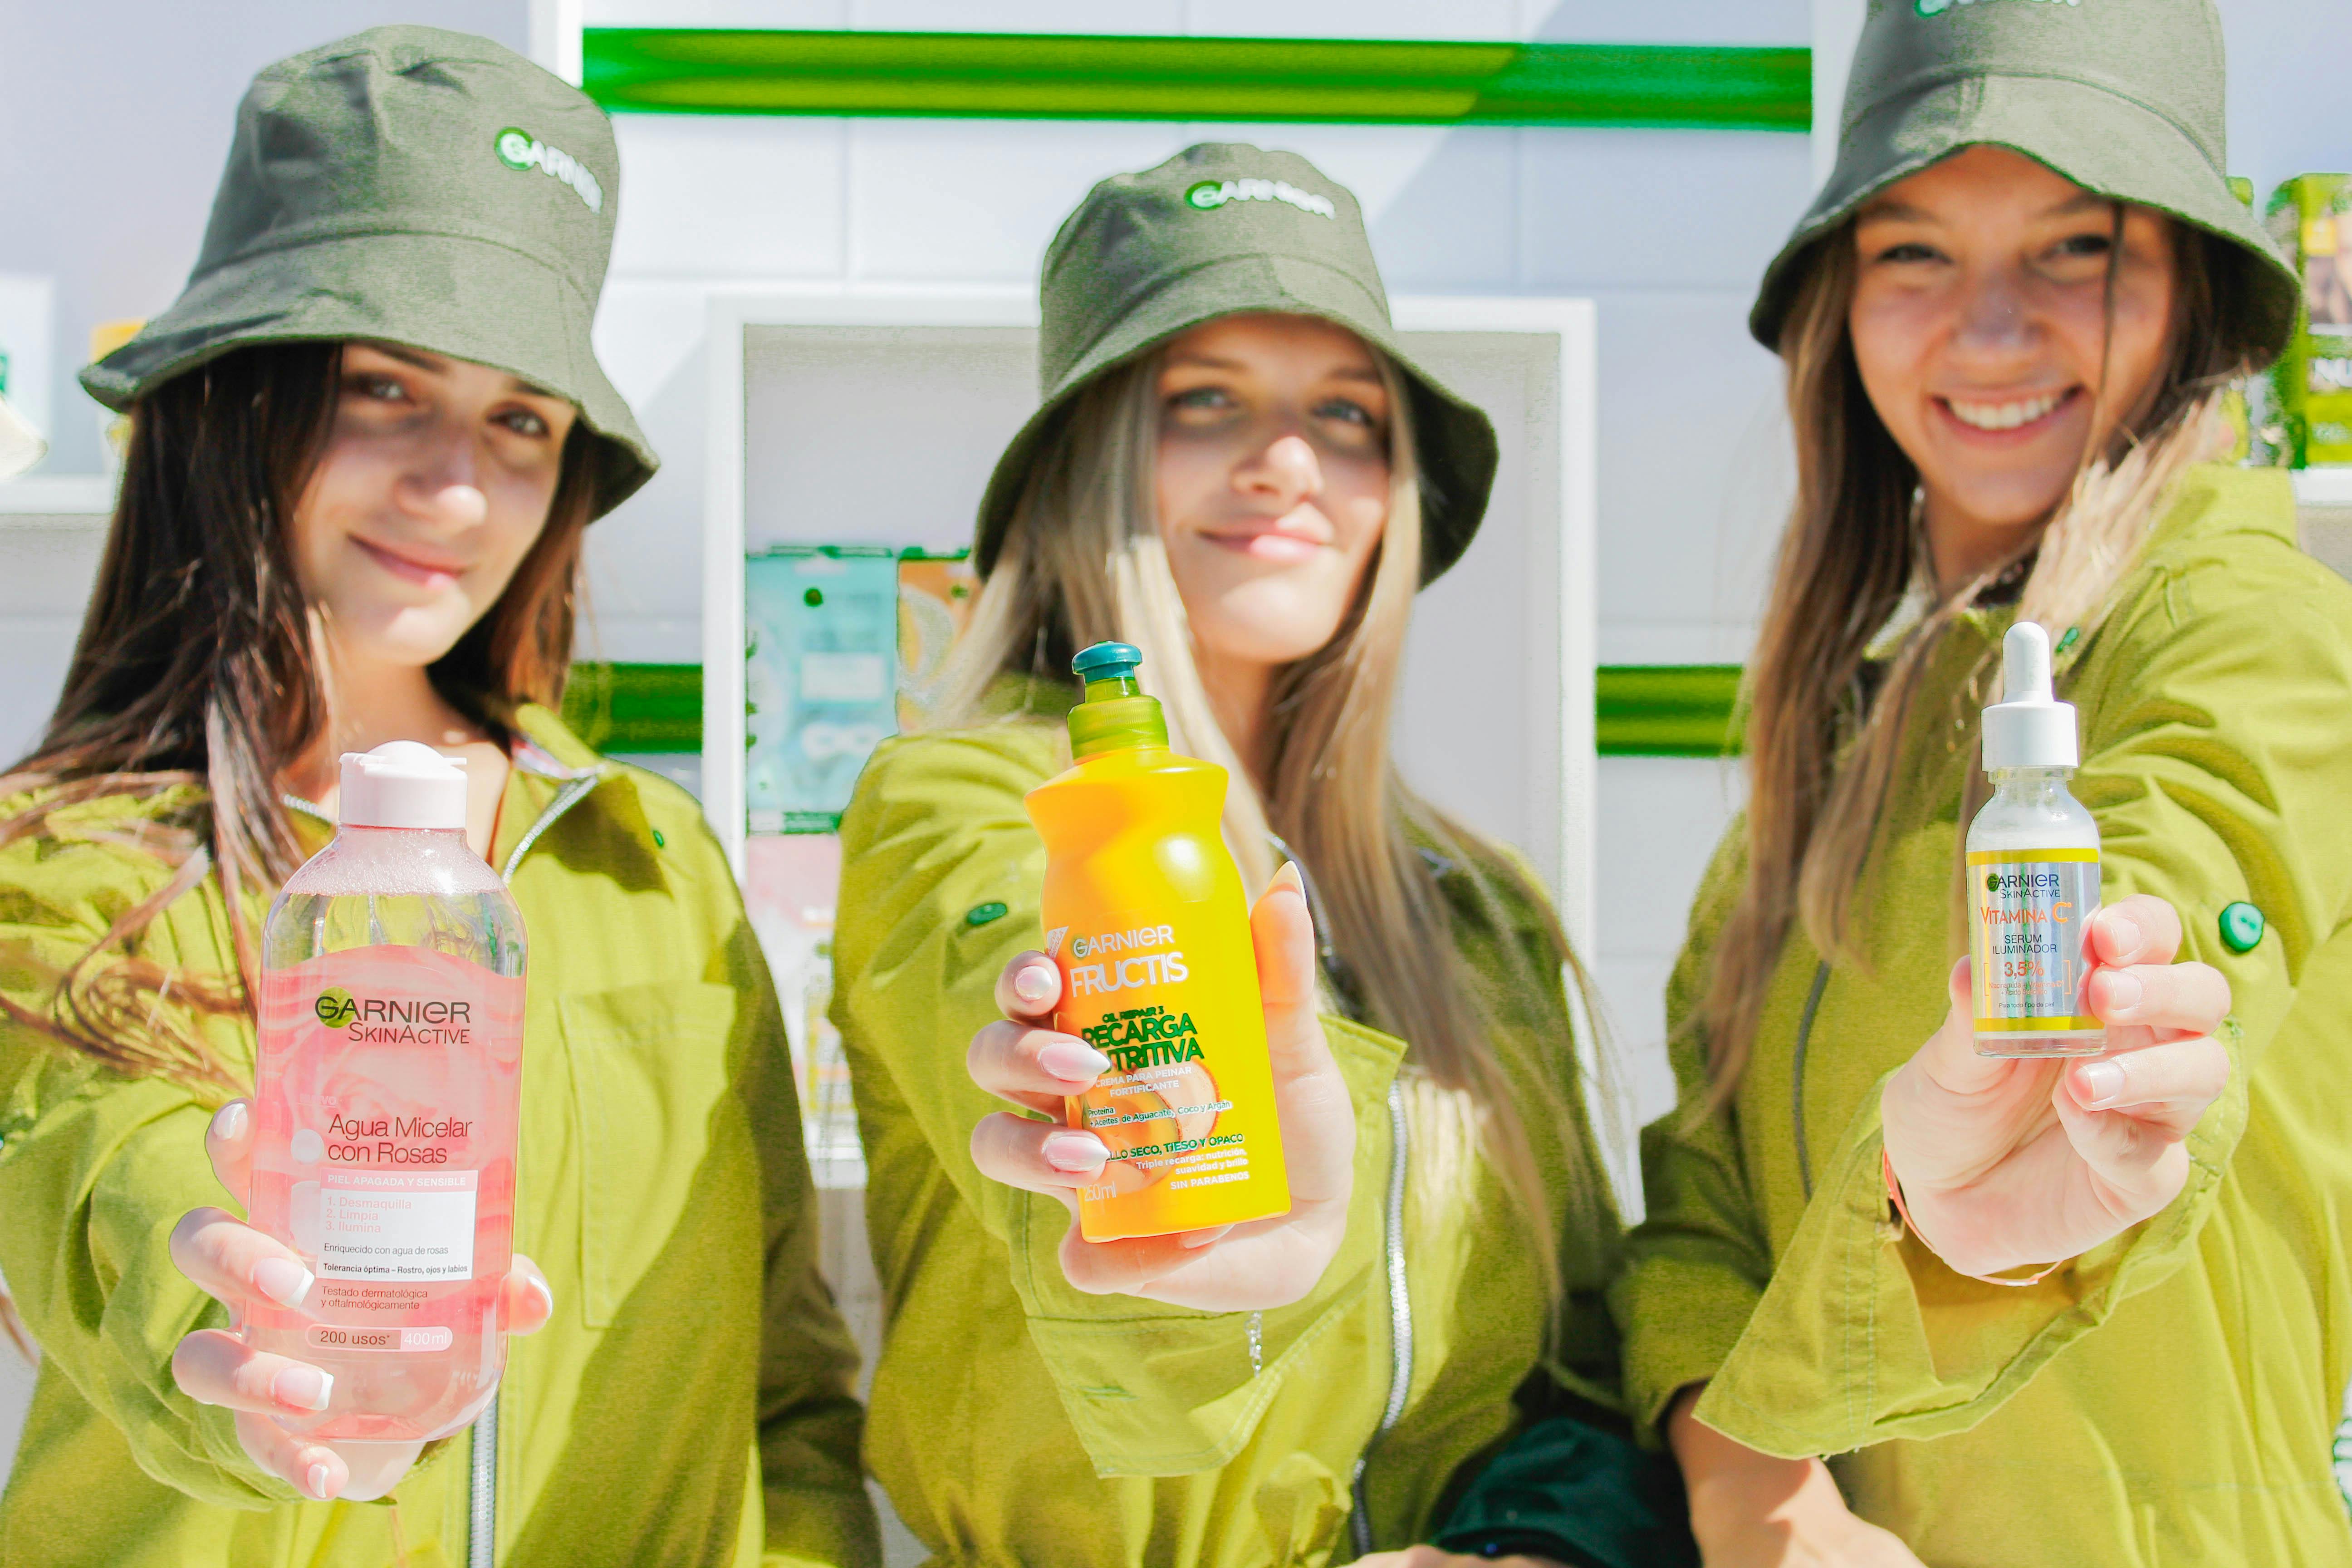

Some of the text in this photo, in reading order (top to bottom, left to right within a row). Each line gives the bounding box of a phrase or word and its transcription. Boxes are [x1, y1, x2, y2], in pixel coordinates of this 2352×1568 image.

[1987, 874, 2059, 889] GARNIER
[1980, 907, 2048, 925] VITAMINA
[1073, 925, 1174, 958] GARNIER
[2005, 933, 2042, 944] SÉRUM
[1993, 944, 2057, 955] ILUMINADOR
[1070, 951, 1189, 997] FRUCTIS
[2004, 960, 2044, 980] 3,5%
[314, 996, 470, 1024] GARNIER
[1119, 1007, 1156, 1020] REPAIR
[1082, 1013, 1198, 1048] RECARGA
[1102, 1038, 1205, 1073] TRITIVA
[1095, 1066, 1192, 1088] CREMA PARA PEINAR
[1109, 1080, 1179, 1097] FORTIFICANTE
[1094, 1118, 1118, 1127] Aceites
[1133, 1109, 1175, 1121] Aguacate,
[1177, 1105, 1199, 1114] Coco
[1200, 1104, 1205, 1113] y
[1208, 1101, 1230, 1112] Argán
[328, 1114, 472, 1141] Agua Micelar
[328, 1142, 447, 1164] con Rosas
[1130, 1145, 1162, 1157] SECO,
[1163, 1140, 1197, 1152] TIESO
[1199, 1139, 1206, 1147] Y
[1209, 1134, 1244, 1147] OPACO
[1136, 1159, 1163, 1170] Triple
[1165, 1154, 1204, 1166] recarga:
[1176, 1162, 1218, 1175] suavidad
[1226, 1158, 1248, 1168] brillo
[328, 1174, 466, 1186] PIEL APAGADA Y SENSIBLE
[1170, 1171, 1250, 1190] SIN PARABENOS
[328, 1197, 412, 1210] 1. Desmaquilla
[326, 1209, 378, 1222] 2. Limpia
[325, 1221, 381, 1233] 3. Ilumina
[324, 1243, 449, 1257] Enriquecido con agua de rosas
[323, 1263, 362, 1273] Tolerancia
[363, 1264, 390, 1275] óptima
[397, 1266, 425, 1275] Rostro,
[426, 1265, 441, 1275] ojos
[442, 1267, 446, 1275] y
[322, 1286, 428, 1300] Testado dermatológica
[328, 1299, 420, 1311] oftalmológicamente
[320, 1331, 346, 1343] 200
